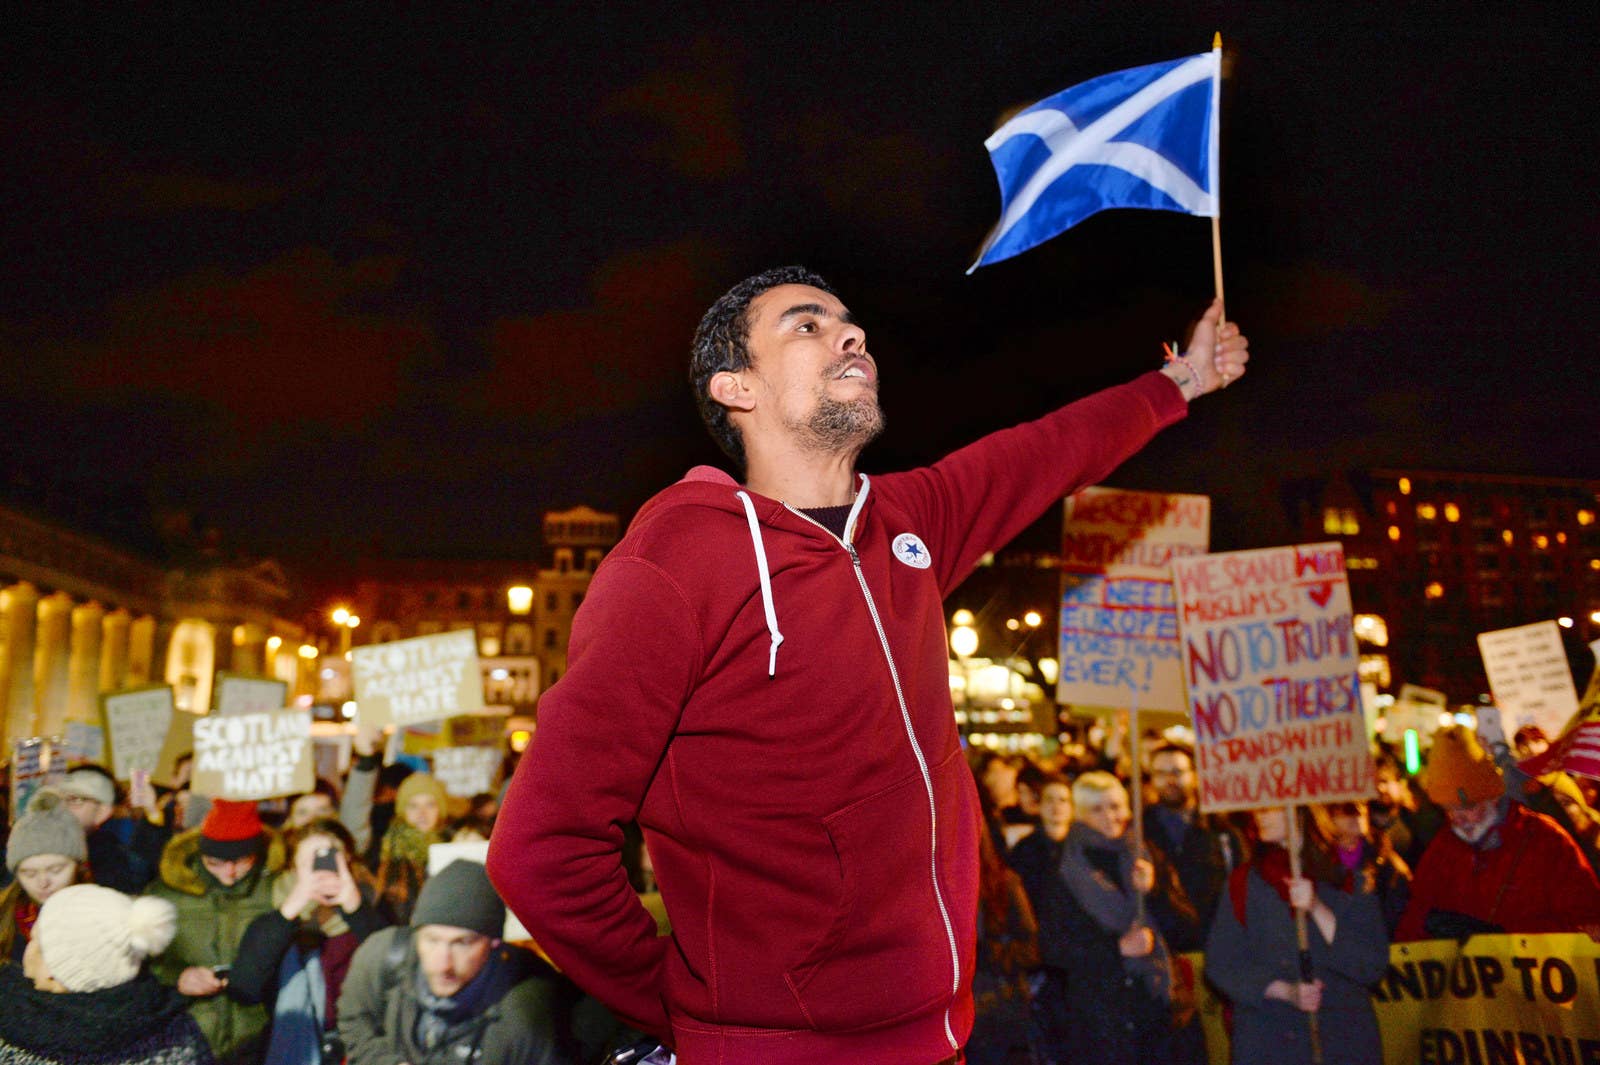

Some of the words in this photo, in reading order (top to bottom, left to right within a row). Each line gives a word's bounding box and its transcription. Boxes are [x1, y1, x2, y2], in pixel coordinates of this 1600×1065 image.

[1178, 558, 1219, 598] WE
[1063, 606, 1177, 639] EUROPE
[1183, 589, 1288, 624] MUSLIMS
[1186, 627, 1242, 687] NO
[1238, 619, 1277, 674] TO
[1192, 690, 1238, 744] NO
[1233, 685, 1270, 731] TO
[223, 765, 295, 794] HATE
[1511, 956, 1578, 1004] TO
